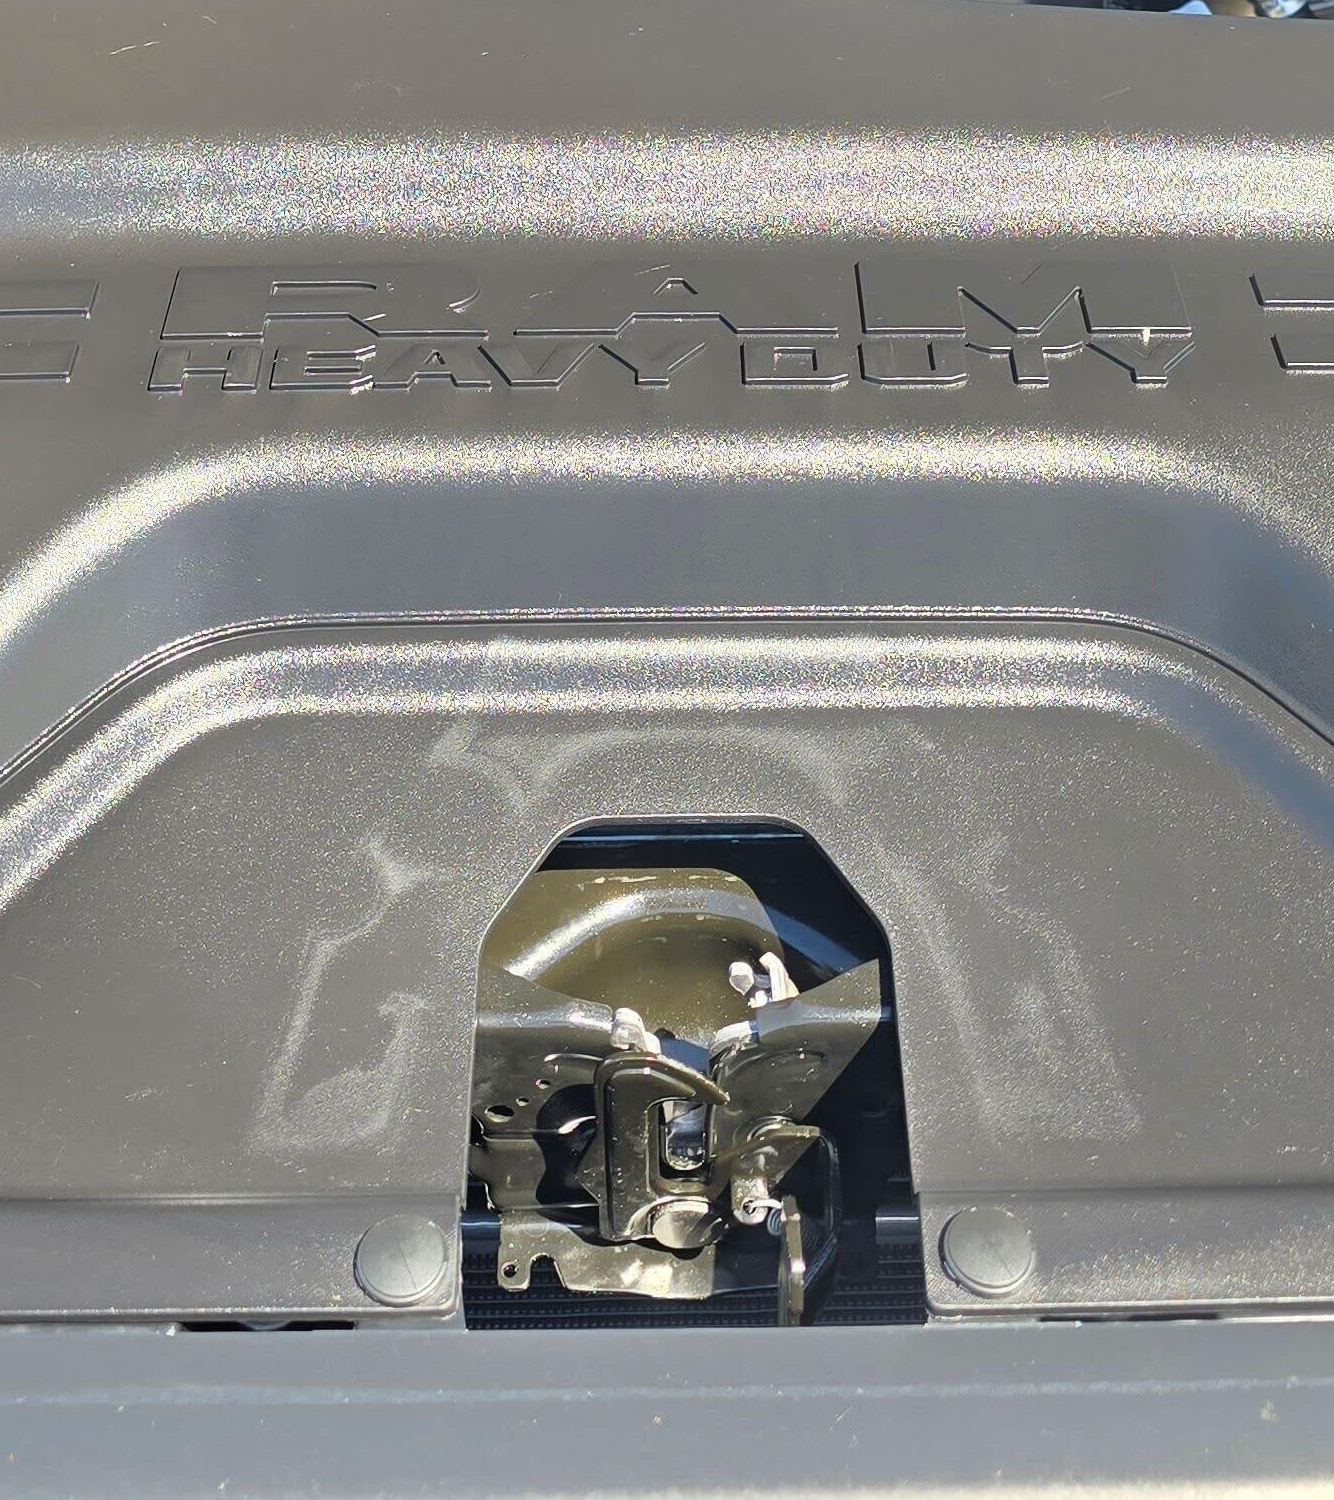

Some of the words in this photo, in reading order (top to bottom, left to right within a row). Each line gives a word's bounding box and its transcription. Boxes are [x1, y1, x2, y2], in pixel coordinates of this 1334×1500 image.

[159, 261, 1193, 341] RAM
[147, 342, 708, 393] HEAVY
[739, 341, 1196, 389] DUTY
